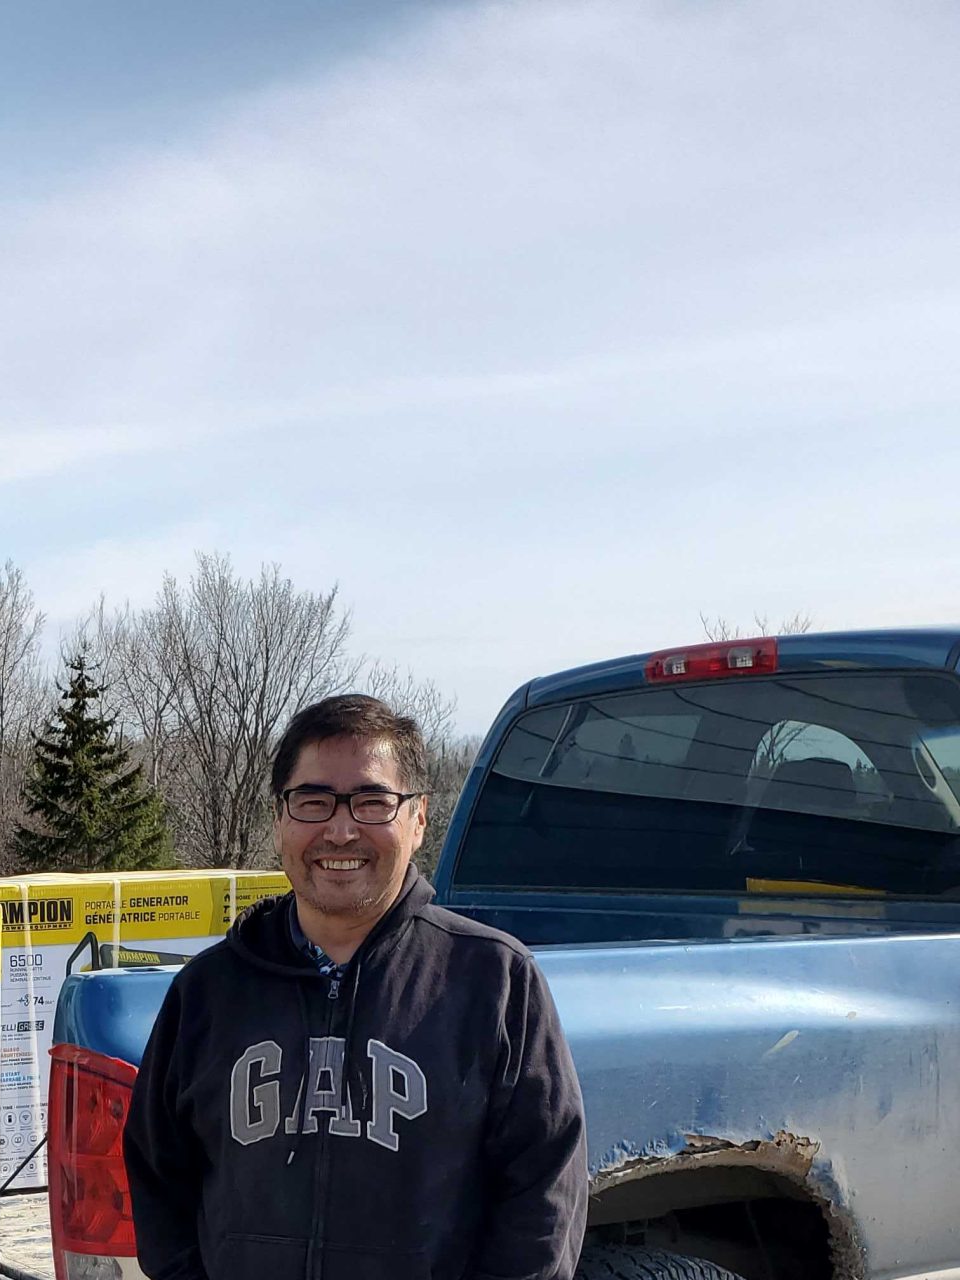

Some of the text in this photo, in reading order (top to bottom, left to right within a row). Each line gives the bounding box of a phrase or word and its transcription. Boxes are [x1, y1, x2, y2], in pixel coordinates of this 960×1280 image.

[129, 895, 189, 908] GENERATOR
[85, 911, 201, 925] GÉNÉATRICE PORTABLE
[9, 954, 43, 968] 6500
[33, 996, 44, 1006] 74
[230, 1035, 428, 1152] GAP
